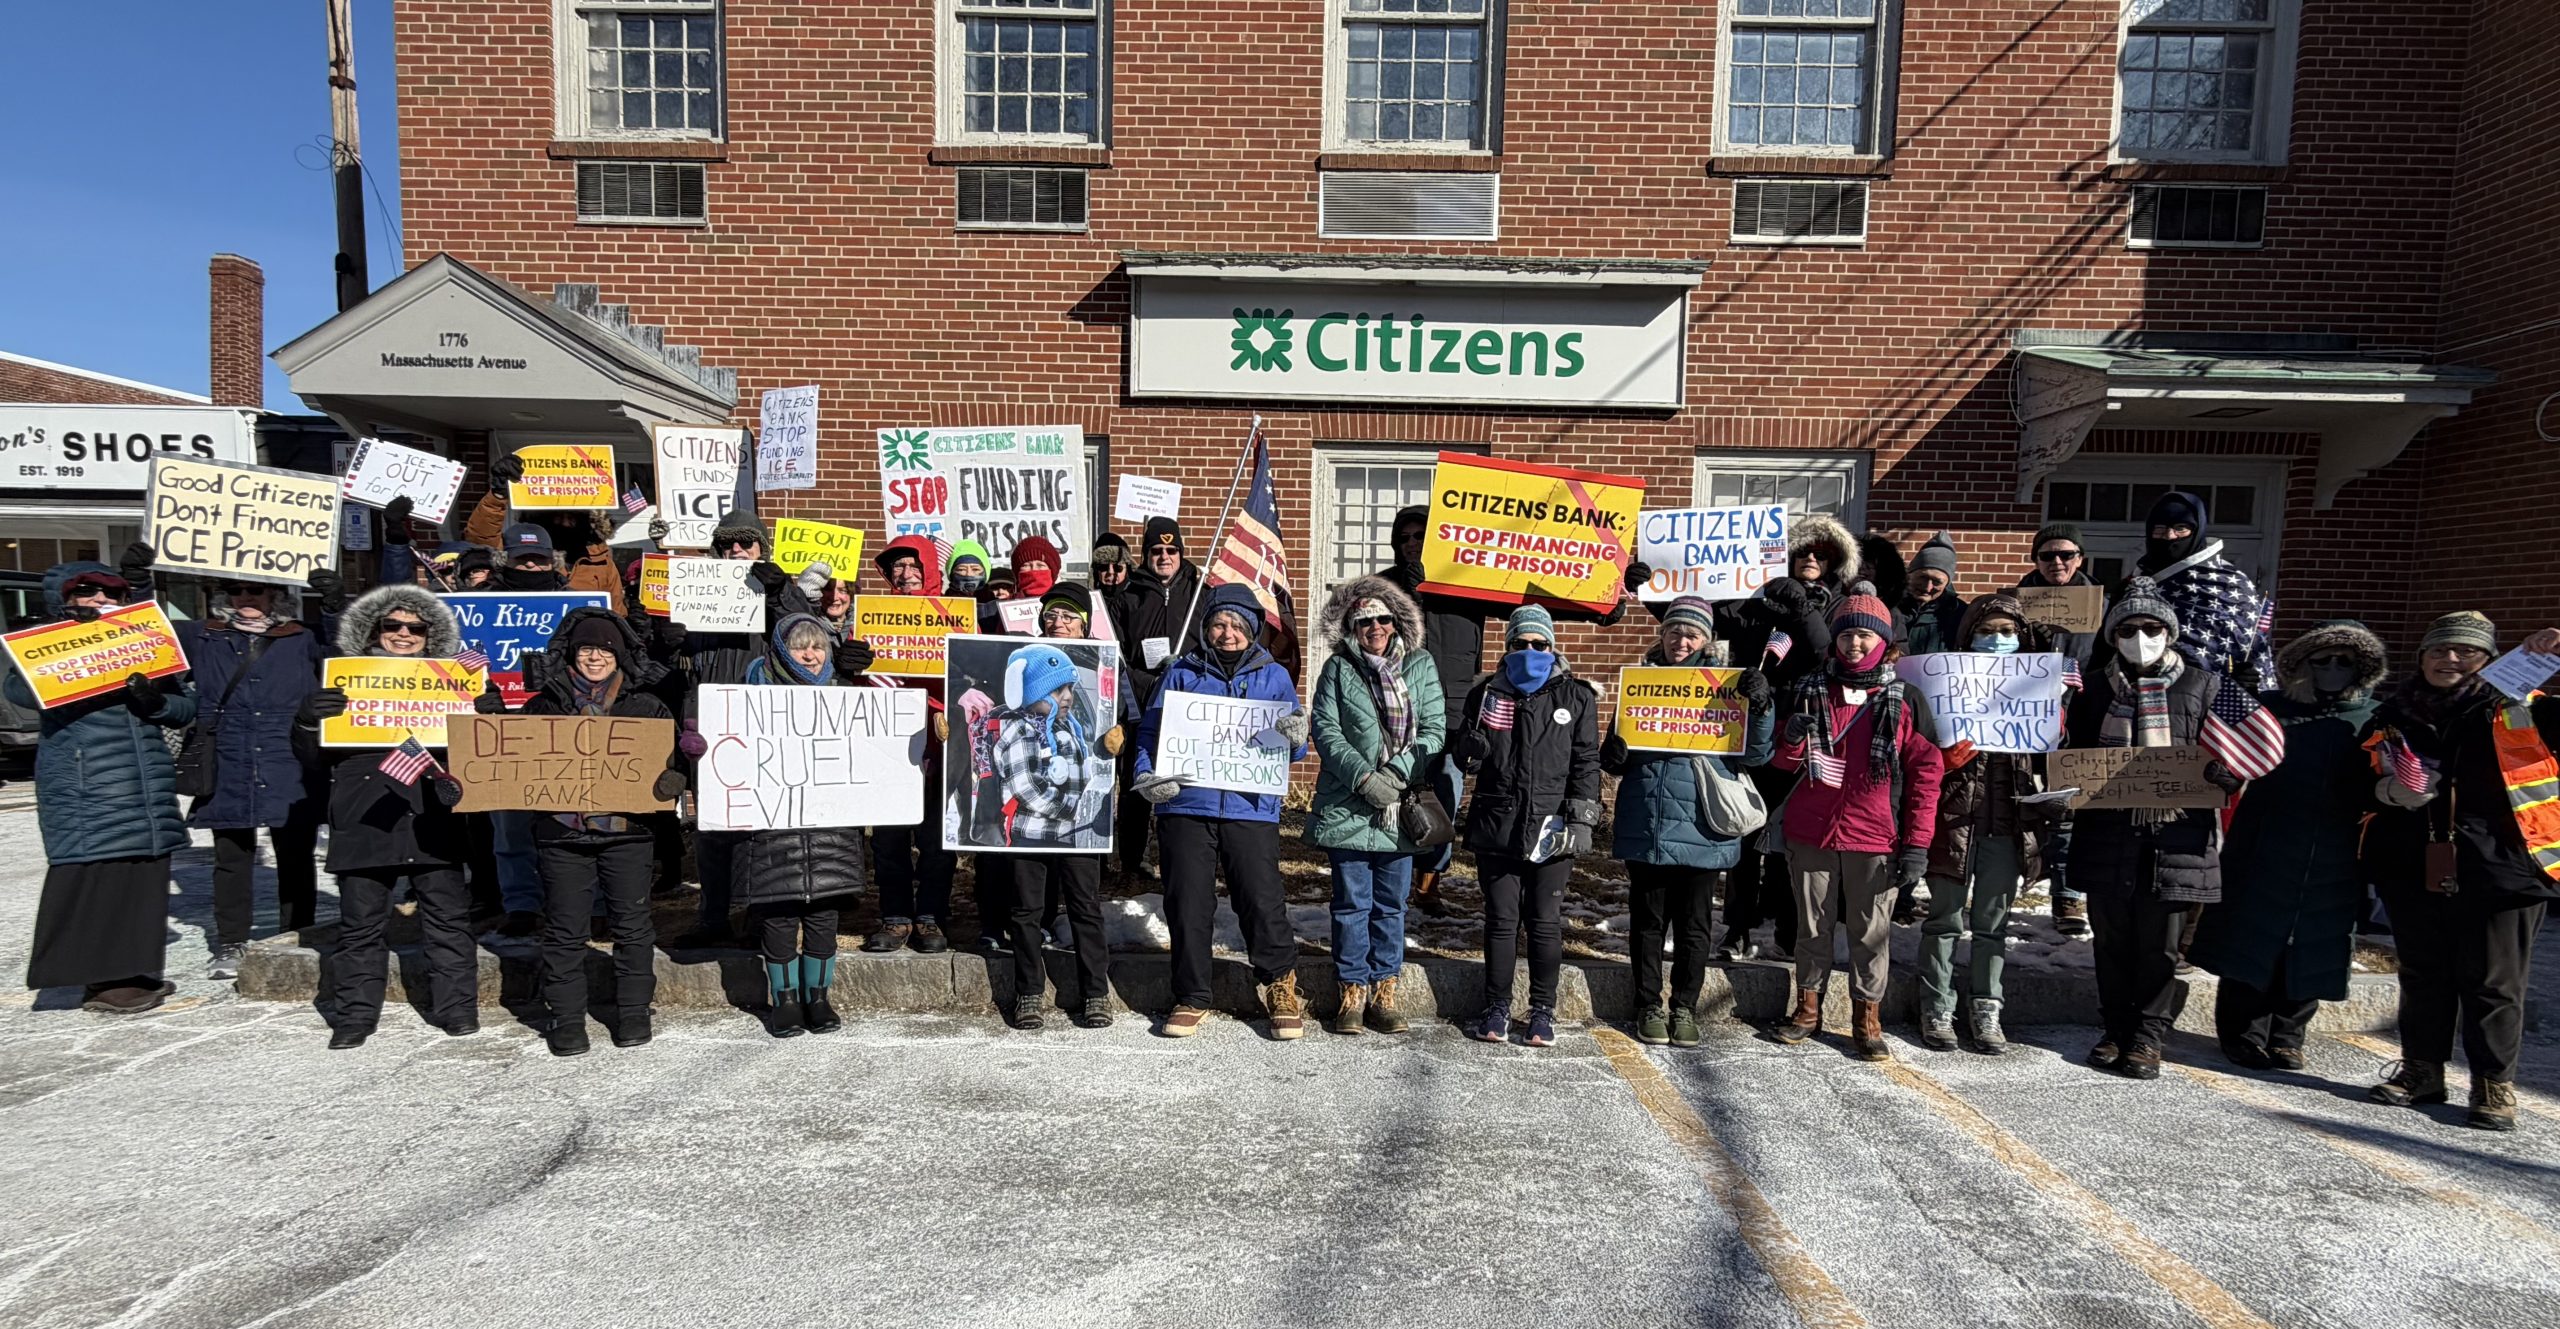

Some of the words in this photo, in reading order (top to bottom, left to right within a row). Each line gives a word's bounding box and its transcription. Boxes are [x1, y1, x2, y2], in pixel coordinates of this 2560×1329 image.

[439, 333, 469, 347] 1776
[1306, 312, 1585, 378] Citizens
[381, 353, 474, 368] Massachusetts
[477, 356, 527, 370] Avenue
[765, 396, 814, 412] CITIZENS
[770, 411, 807, 425] BANK
[763, 426, 807, 444] STOP
[933, 432, 1017, 453] CITIZENS
[1025, 433, 1064, 455] BANK
[62, 432, 216, 463] SHOES
[760, 447, 804, 459] FUNDING
[19, 466, 48, 476] EST.
[55, 466, 84, 477] 1919
[404, 454, 428, 469] ICE
[521, 459, 567, 468] ITIZENS
[570, 459, 609, 469] BANK:
[769, 458, 797, 473] ICE
[365, 477, 391, 492] for
[386, 463, 434, 487] OUT
[548, 476, 609, 485] FINANCING
[684, 467, 735, 484] FUNDS
[158, 466, 224, 494] Good
[230, 475, 335, 511] Citizens
[528, 487, 545, 495] ICE
[549, 487, 600, 495] PRISONS!
[888, 475, 948, 515] STOP
[959, 467, 1073, 511] FUNDING
[157, 495, 222, 525] Don't
[233, 504, 330, 539] Finance
[678, 493, 731, 520] ICE
[1442, 489, 1548, 520] CITIZENS
[1553, 504, 1626, 531] BANK:
[1645, 506, 1783, 544] CITIZEN'S
[154, 524, 211, 563] ICE
[221, 531, 328, 573] Prisons
[781, 526, 812, 543] ICE
[814, 530, 857, 550] OUT
[1438, 523, 1494, 545] STOP
[1499, 531, 1616, 561] FINANCING
[781, 551, 850, 571] CITIZENS
[1453, 547, 1488, 566] ICE
[1494, 553, 1593, 579] PRISONS!
[1684, 543, 1749, 566] BANK
[646, 569, 669, 578] CITIZ
[676, 562, 722, 579] SHAME
[1648, 567, 1705, 593] OUT
[1707, 573, 1727, 584] OF
[673, 585, 728, 597] CITIZENS
[454, 604, 484, 627] No
[675, 602, 718, 613] FUNDING
[729, 605, 746, 614] ICE
[700, 615, 742, 624] PRISONS
[862, 613, 922, 626] CITIZENS
[925, 614, 969, 627] BANK:
[24, 632, 103, 660] CITIZENS
[105, 620, 160, 640] BANK:
[861, 635, 893, 645] STOP
[897, 635, 945, 647] FINANC
[37, 659, 80, 676] STOP
[82, 636, 166, 665] FINANCING
[898, 649, 944, 660] PRISON
[1923, 654, 2049, 678] CITIZENS
[57, 670, 83, 684] ICE
[89, 651, 157, 677] PRISONS!
[334, 676, 416, 690] CITIZENS
[422, 678, 476, 692] BANK:
[1626, 685, 1691, 698] CITIZENS
[1948, 677, 2013, 700] BANK
[348, 700, 379, 711] TOP
[383, 701, 474, 713] FINANCING
[717, 689, 915, 737] INHUMANE
[1186, 701, 1286, 729] CITIZENS
[1625, 706, 1659, 717] STOP
[1662, 707, 1740, 721] FINANCING
[1930, 694, 1989, 715] TIES
[2000, 698, 2056, 718] WITH
[350, 716, 376, 726] ICE
[383, 716, 446, 727] PRISON
[1636, 721, 1656, 731] ICE
[1661, 722, 1726, 736] PRISONS!
[474, 718, 642, 757] DE-ICE
[1212, 725, 1263, 746] BANK
[1952, 717, 2050, 751] PRISONS
[1166, 737, 1201, 755] CUT
[1206, 742, 1251, 760] TIES
[1256, 745, 1289, 762] WITH
[464, 758, 642, 784] CITIZENS
[711, 736, 869, 788] CRUEL
[1166, 756, 1206, 780] ICE
[1212, 759, 1283, 786] PRISONS
[523, 784, 602, 807] BANK
[2150, 780, 2181, 793] ICE
[727, 786, 818, 828] EVIL
